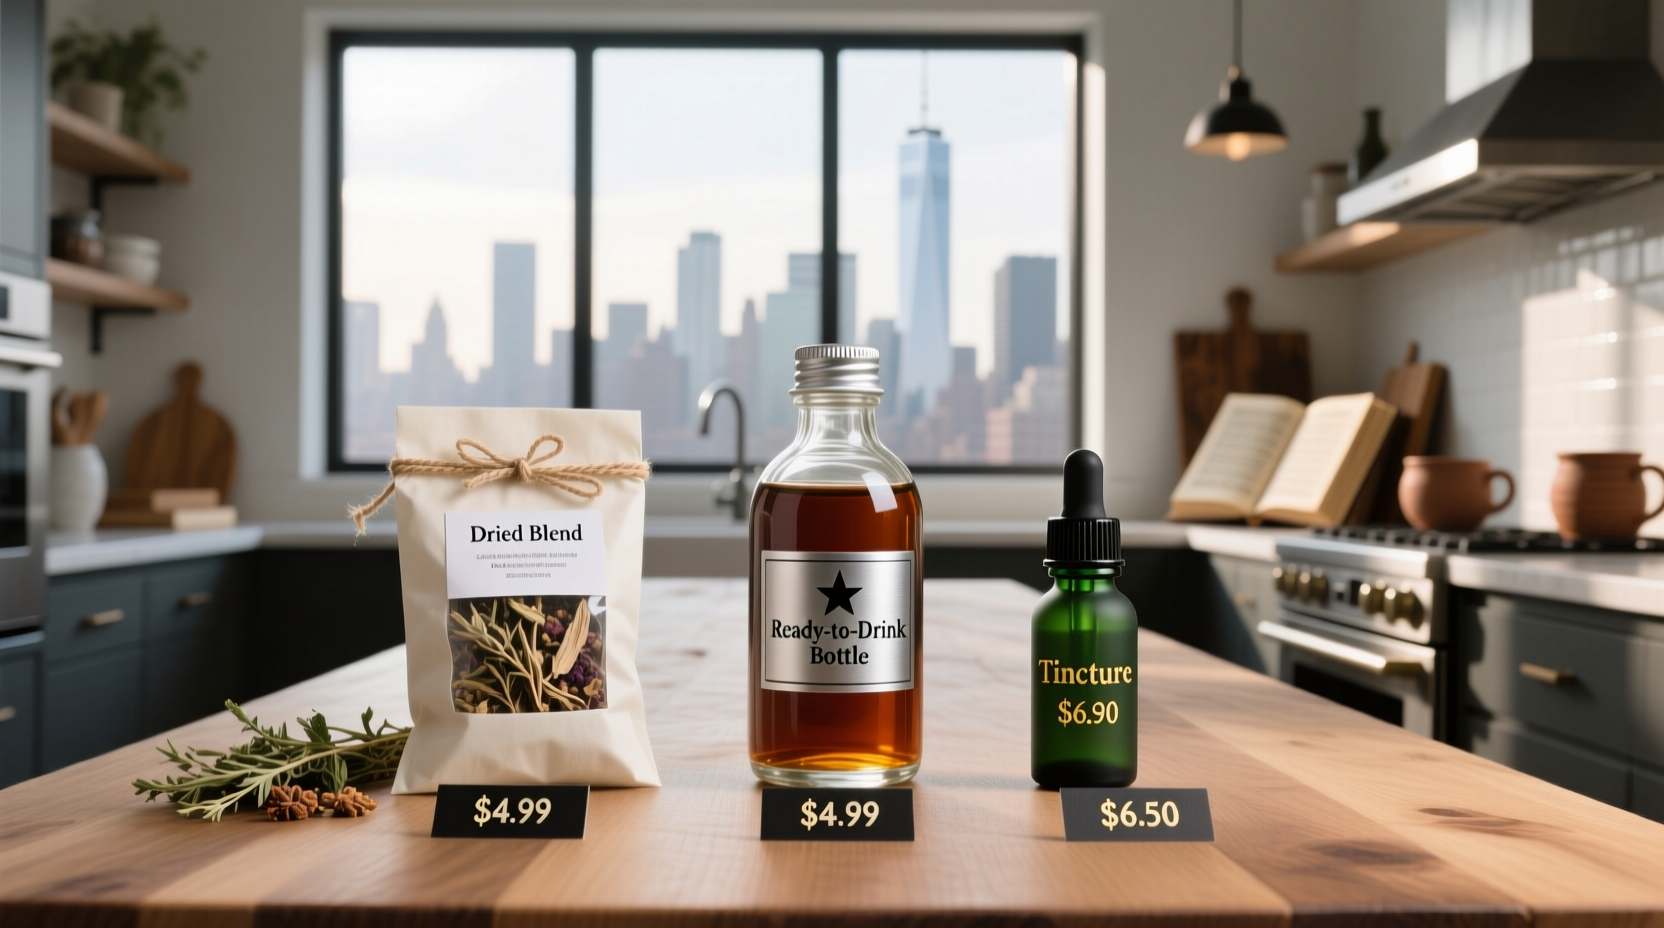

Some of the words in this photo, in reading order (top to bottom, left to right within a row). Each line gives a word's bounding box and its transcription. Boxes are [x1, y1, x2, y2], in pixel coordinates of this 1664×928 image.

[470, 524, 523, 543] Dried
[529, 523, 583, 542] Blend
[771, 618, 907, 644] Ready-to-Drink
[810, 645, 869, 665] Bottle
[1038, 659, 1132, 685] Tincture
[1057, 697, 1119, 728] $6.90
[473, 794, 552, 828] $4.99
[800, 798, 880, 832] $4.99
[1100, 798, 1180, 832] $6.50
